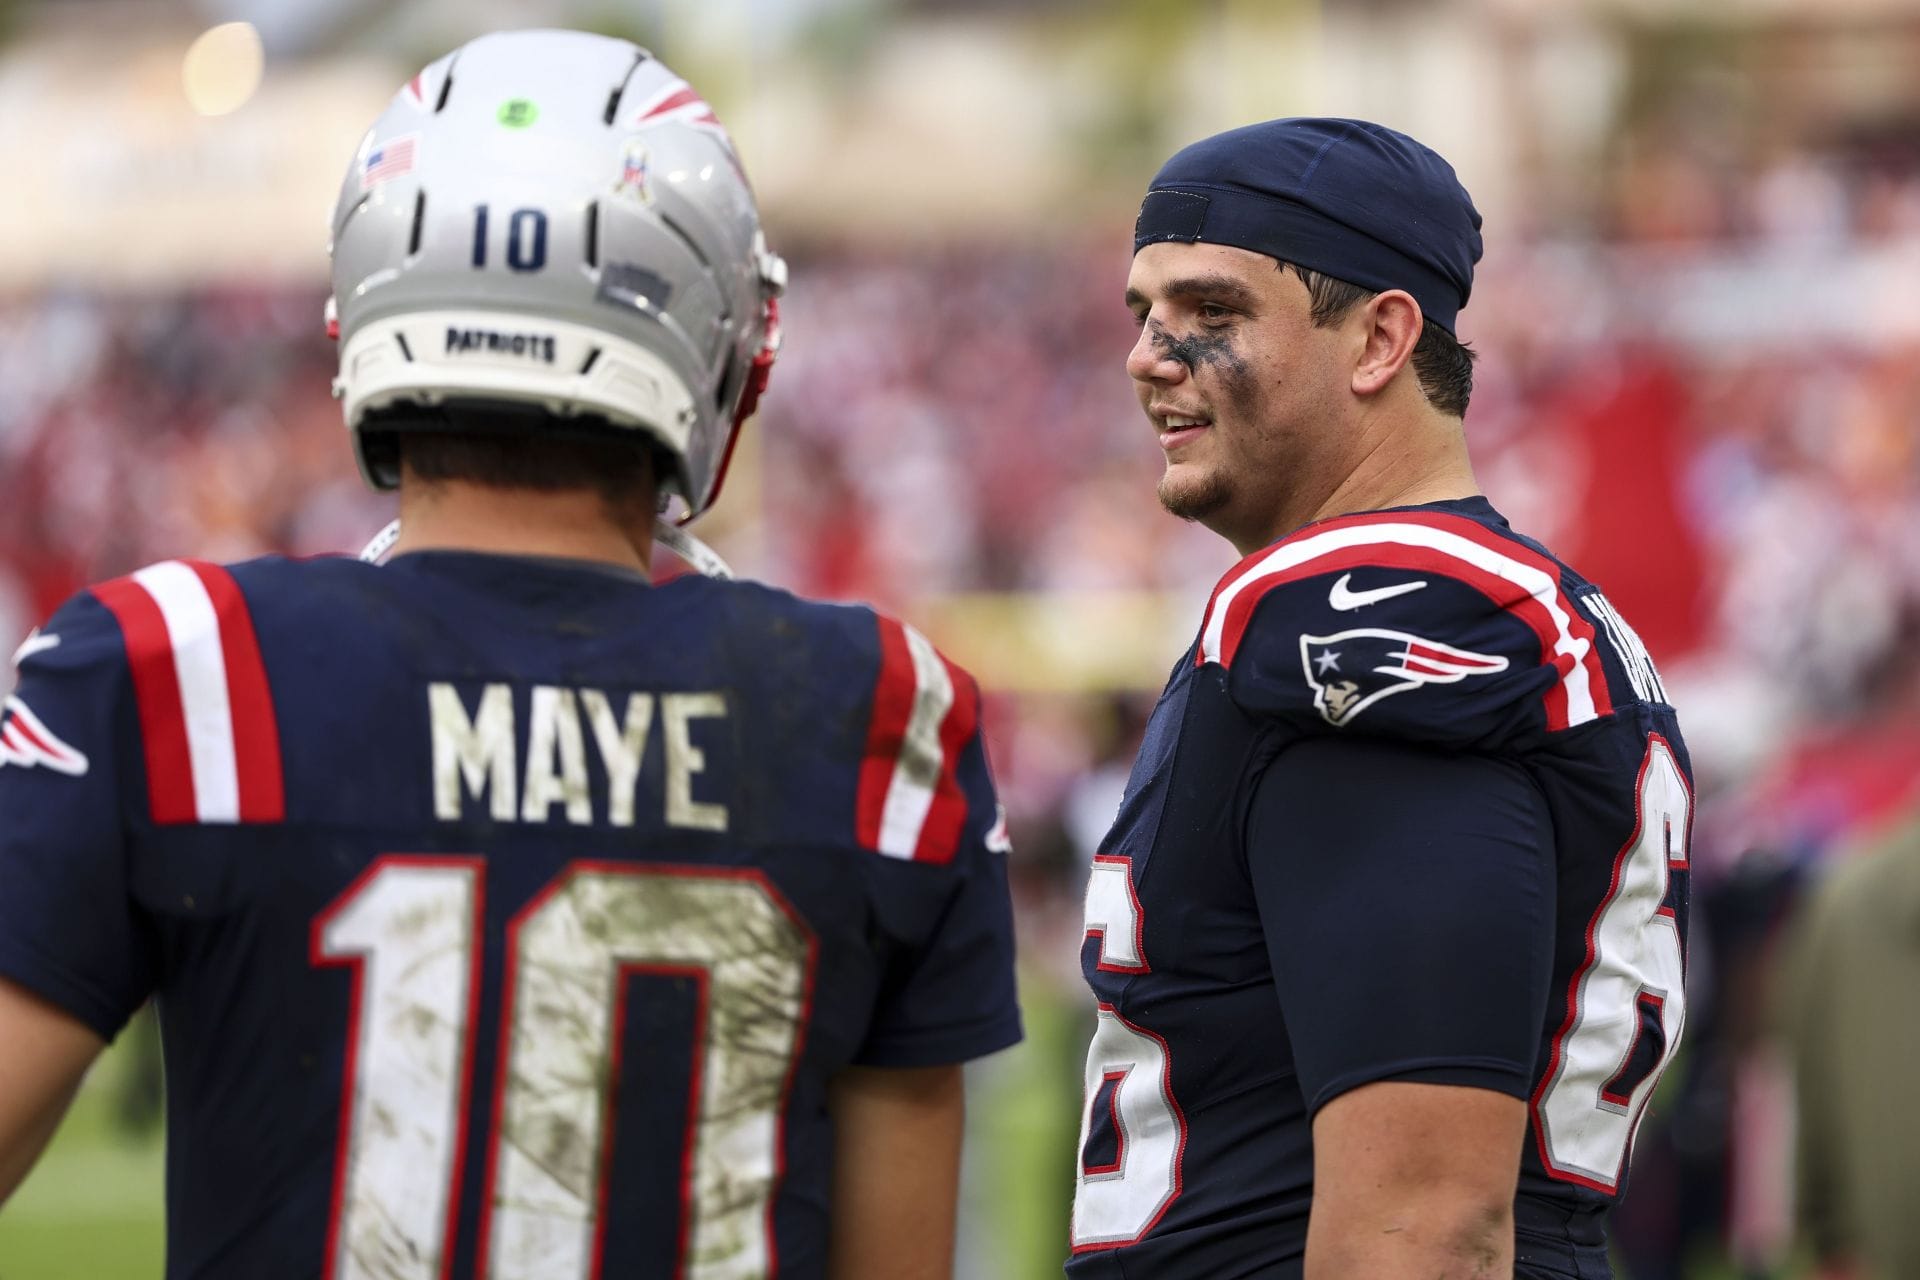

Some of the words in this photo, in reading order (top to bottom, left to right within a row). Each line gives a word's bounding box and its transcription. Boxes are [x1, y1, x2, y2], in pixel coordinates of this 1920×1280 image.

[471, 203, 548, 274] 10
[445, 327, 556, 363] PATRIOTS
[428, 682, 729, 832] MAYE
[310, 853, 818, 1280] 10
